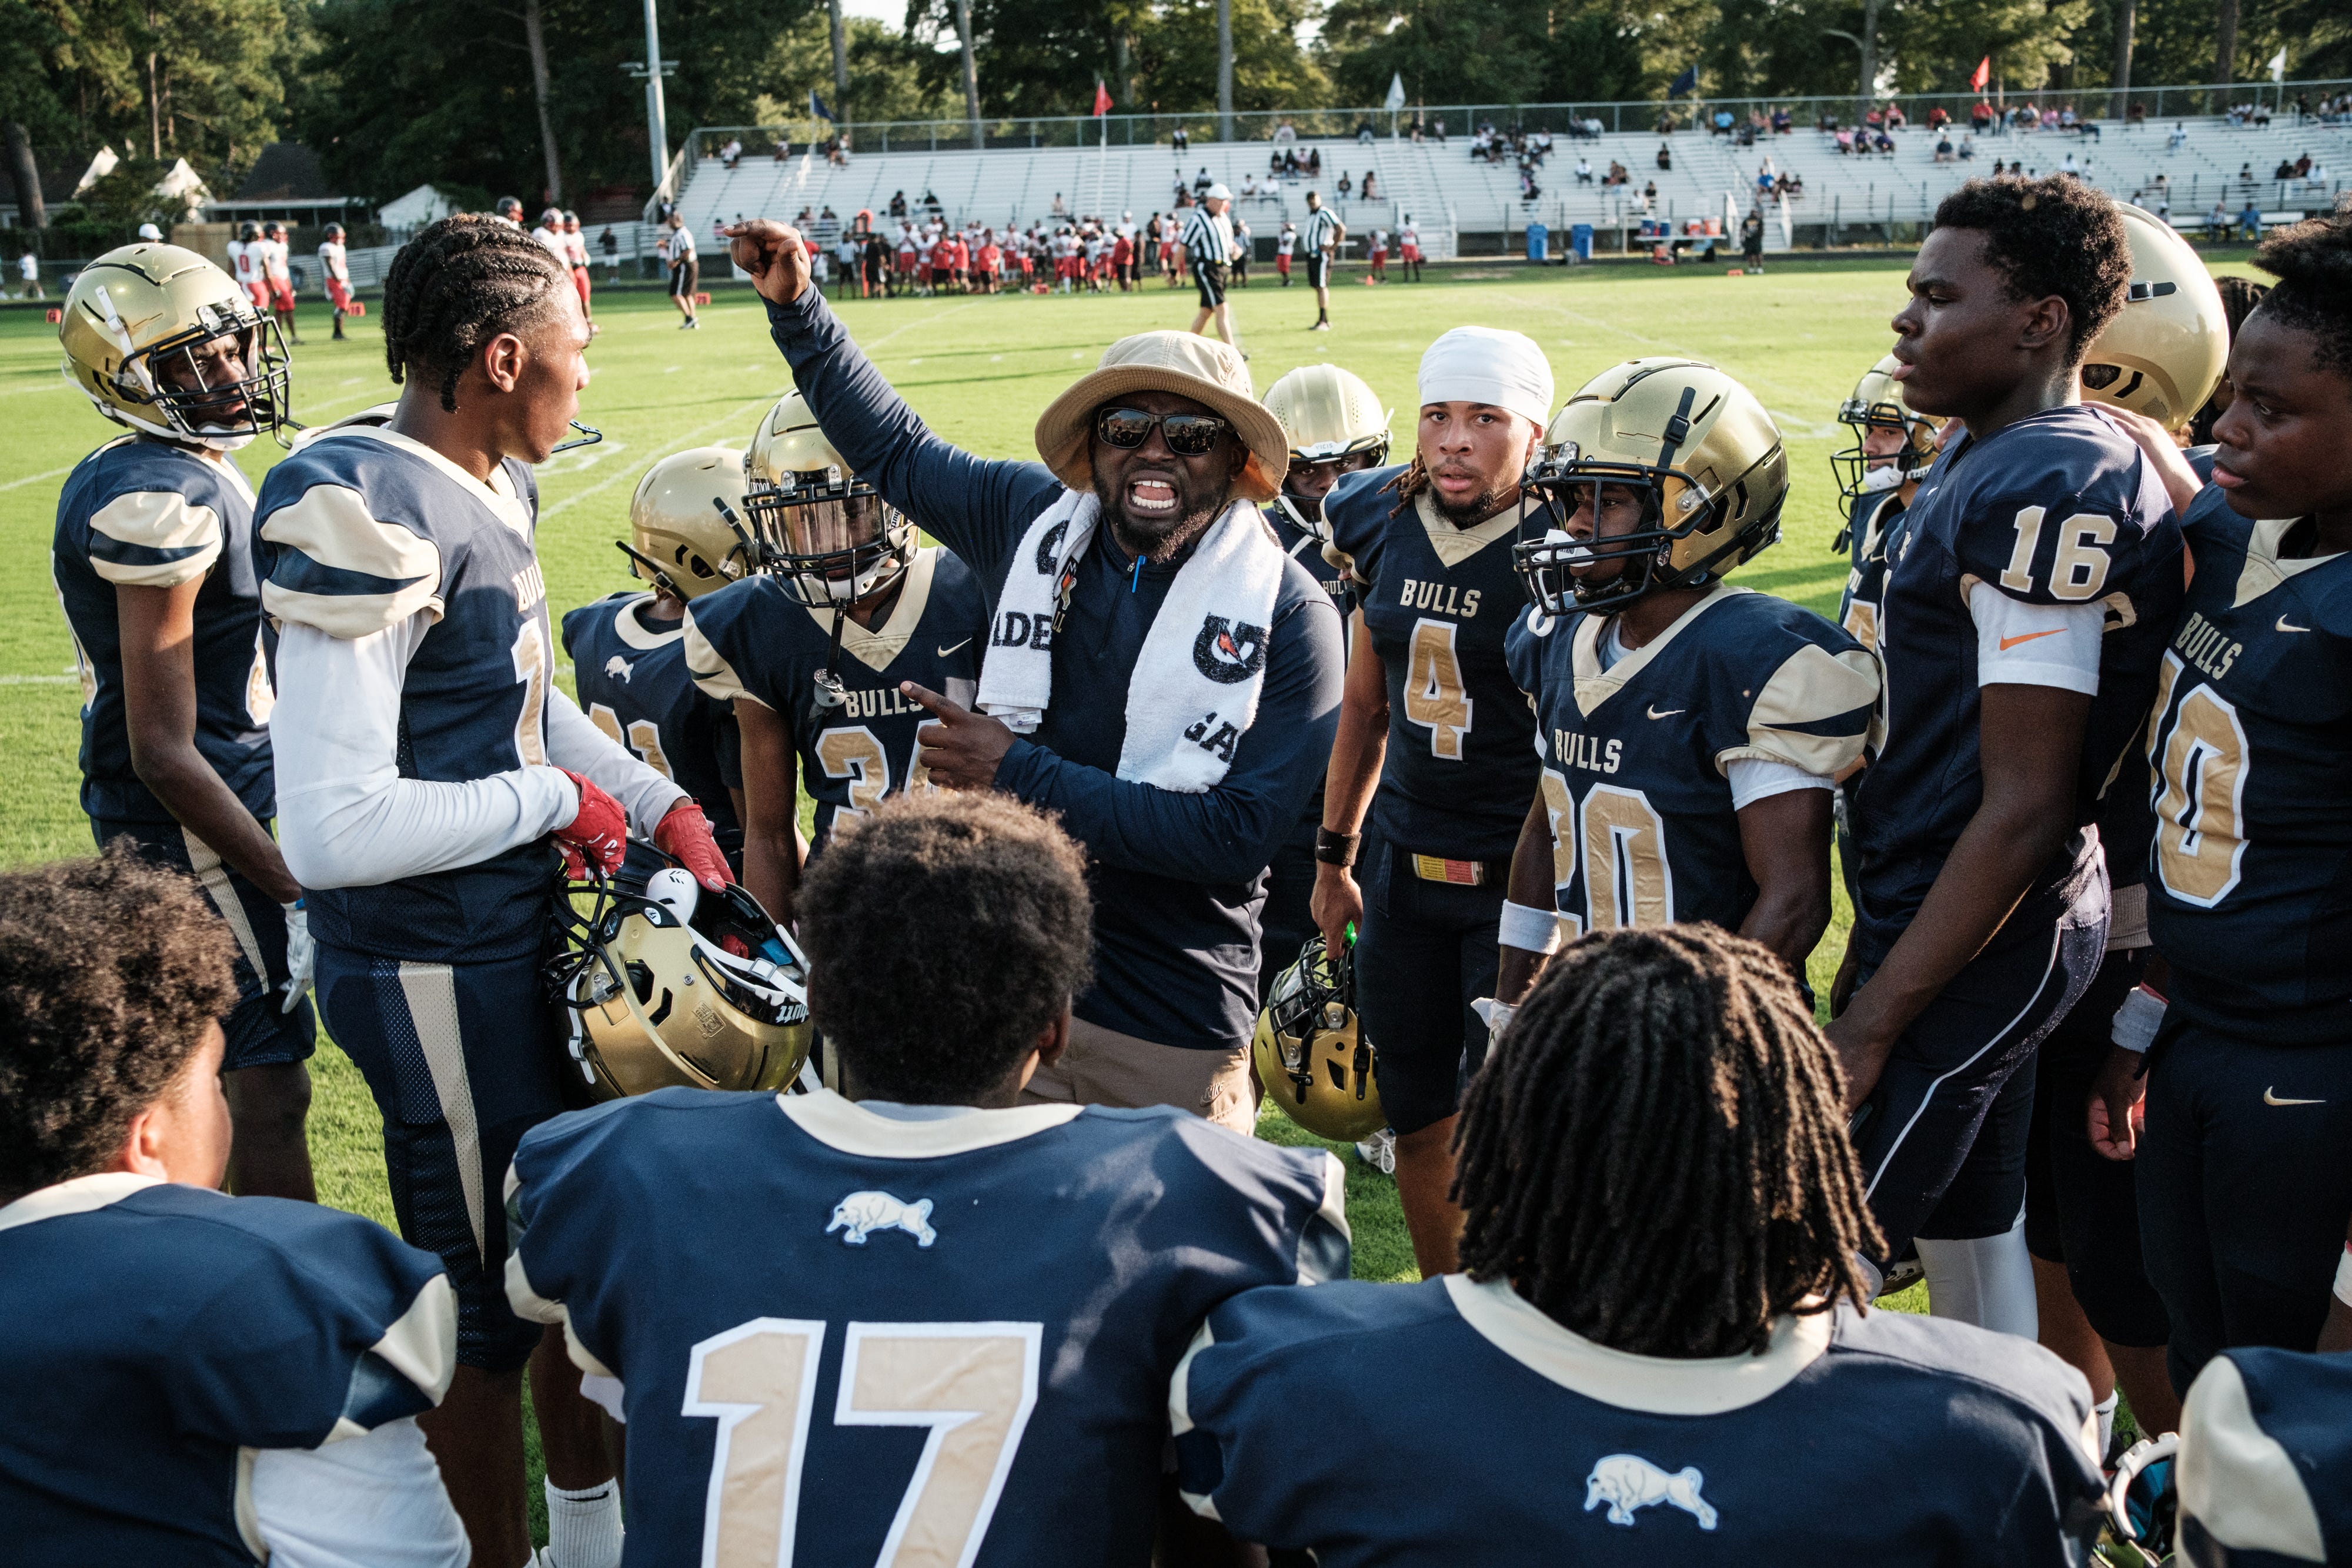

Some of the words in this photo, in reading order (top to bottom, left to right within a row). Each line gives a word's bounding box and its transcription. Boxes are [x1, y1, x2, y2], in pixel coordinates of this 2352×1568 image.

[1400, 579, 1482, 618] BULLS
[2000, 506, 2117, 600] 16
[1404, 617, 1473, 761] 4
[2176, 611, 2243, 680] BULLS
[1555, 728, 1622, 774] BULLS
[2145, 647, 2251, 909] 0
[681, 1316, 1044, 1568] 17
